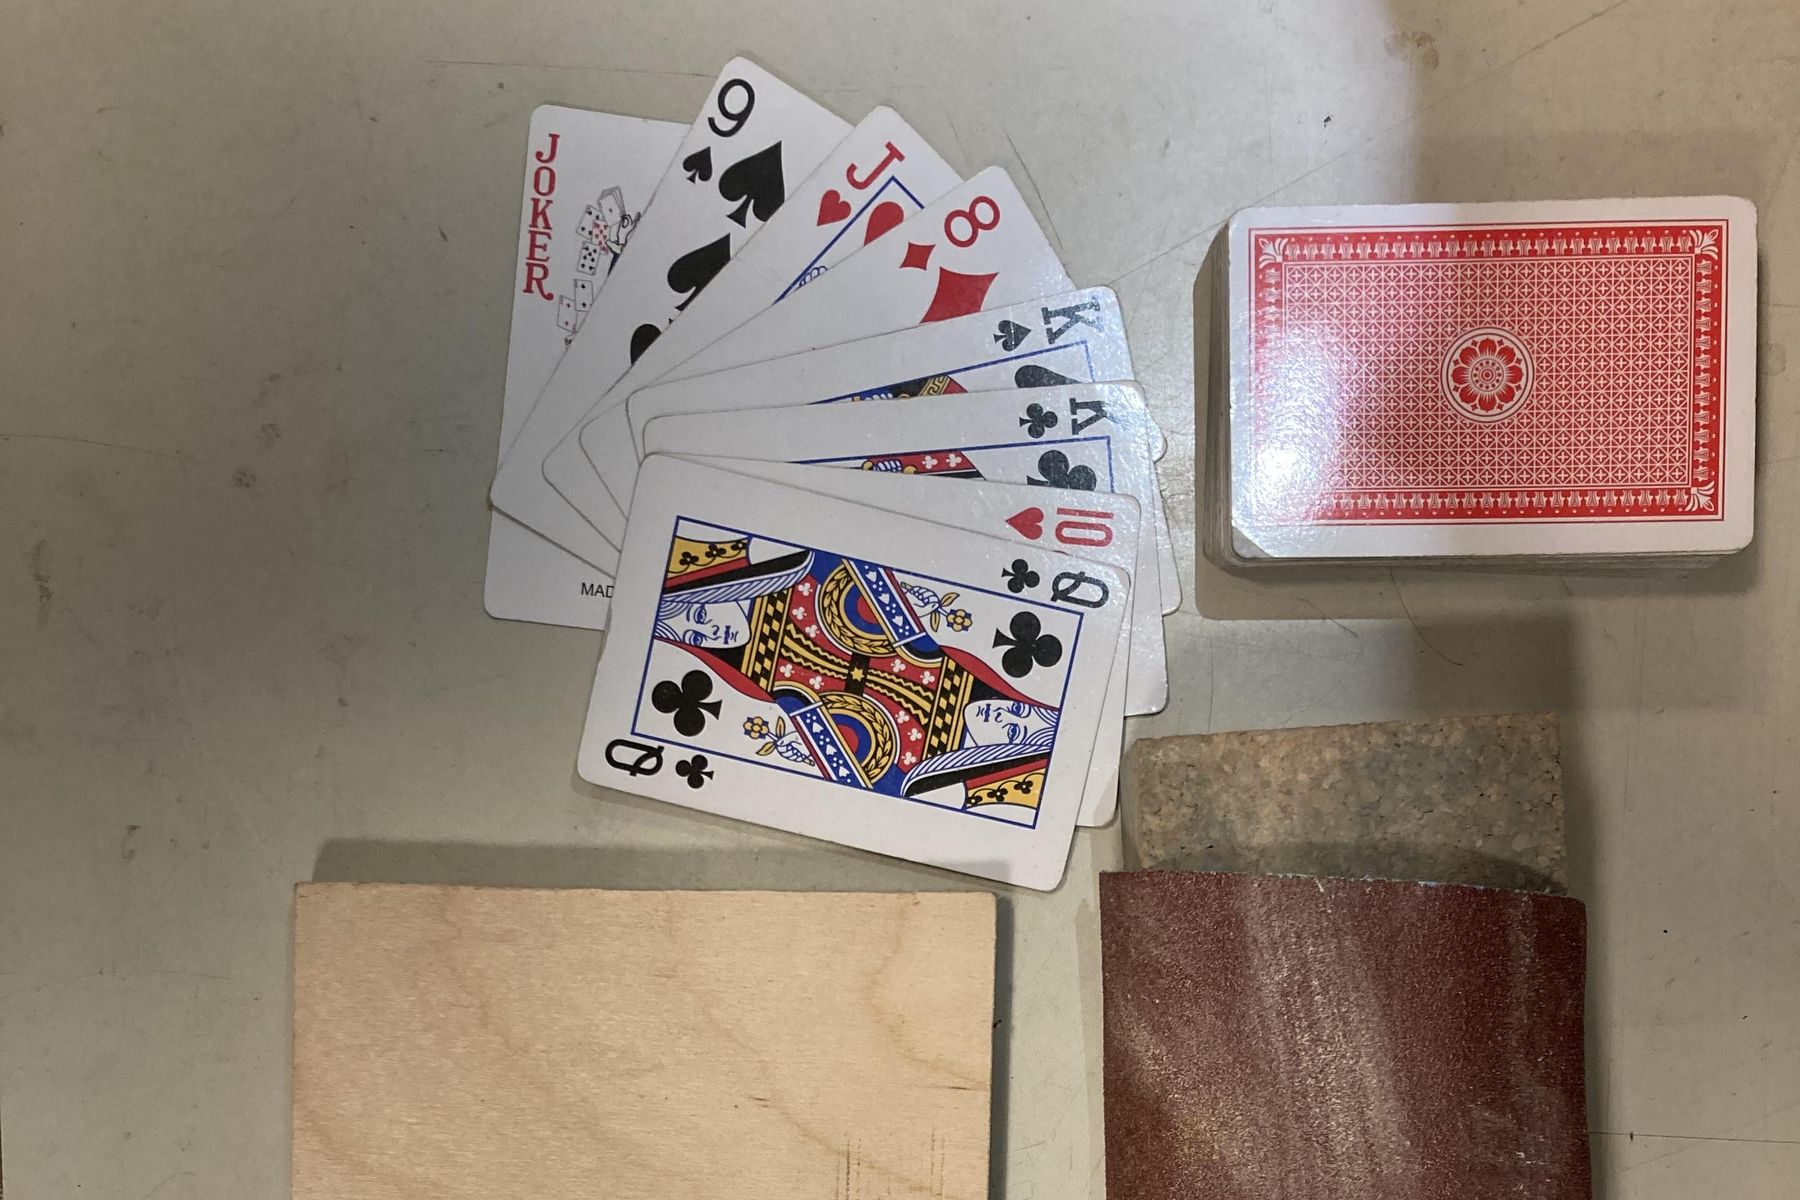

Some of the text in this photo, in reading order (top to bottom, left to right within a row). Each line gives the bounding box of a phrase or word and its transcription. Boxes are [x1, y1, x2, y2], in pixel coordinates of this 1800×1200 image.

[707, 78, 755, 137] 9
[846, 141, 905, 190] J
[523, 132, 560, 301] JOKER
[944, 195, 1000, 248] 8
[1041, 296, 1101, 345] K
[1069, 397, 1123, 435] K
[1055, 507, 1114, 547] 10
[1050, 571, 1109, 608] Q
[605, 739, 664, 776] Q
